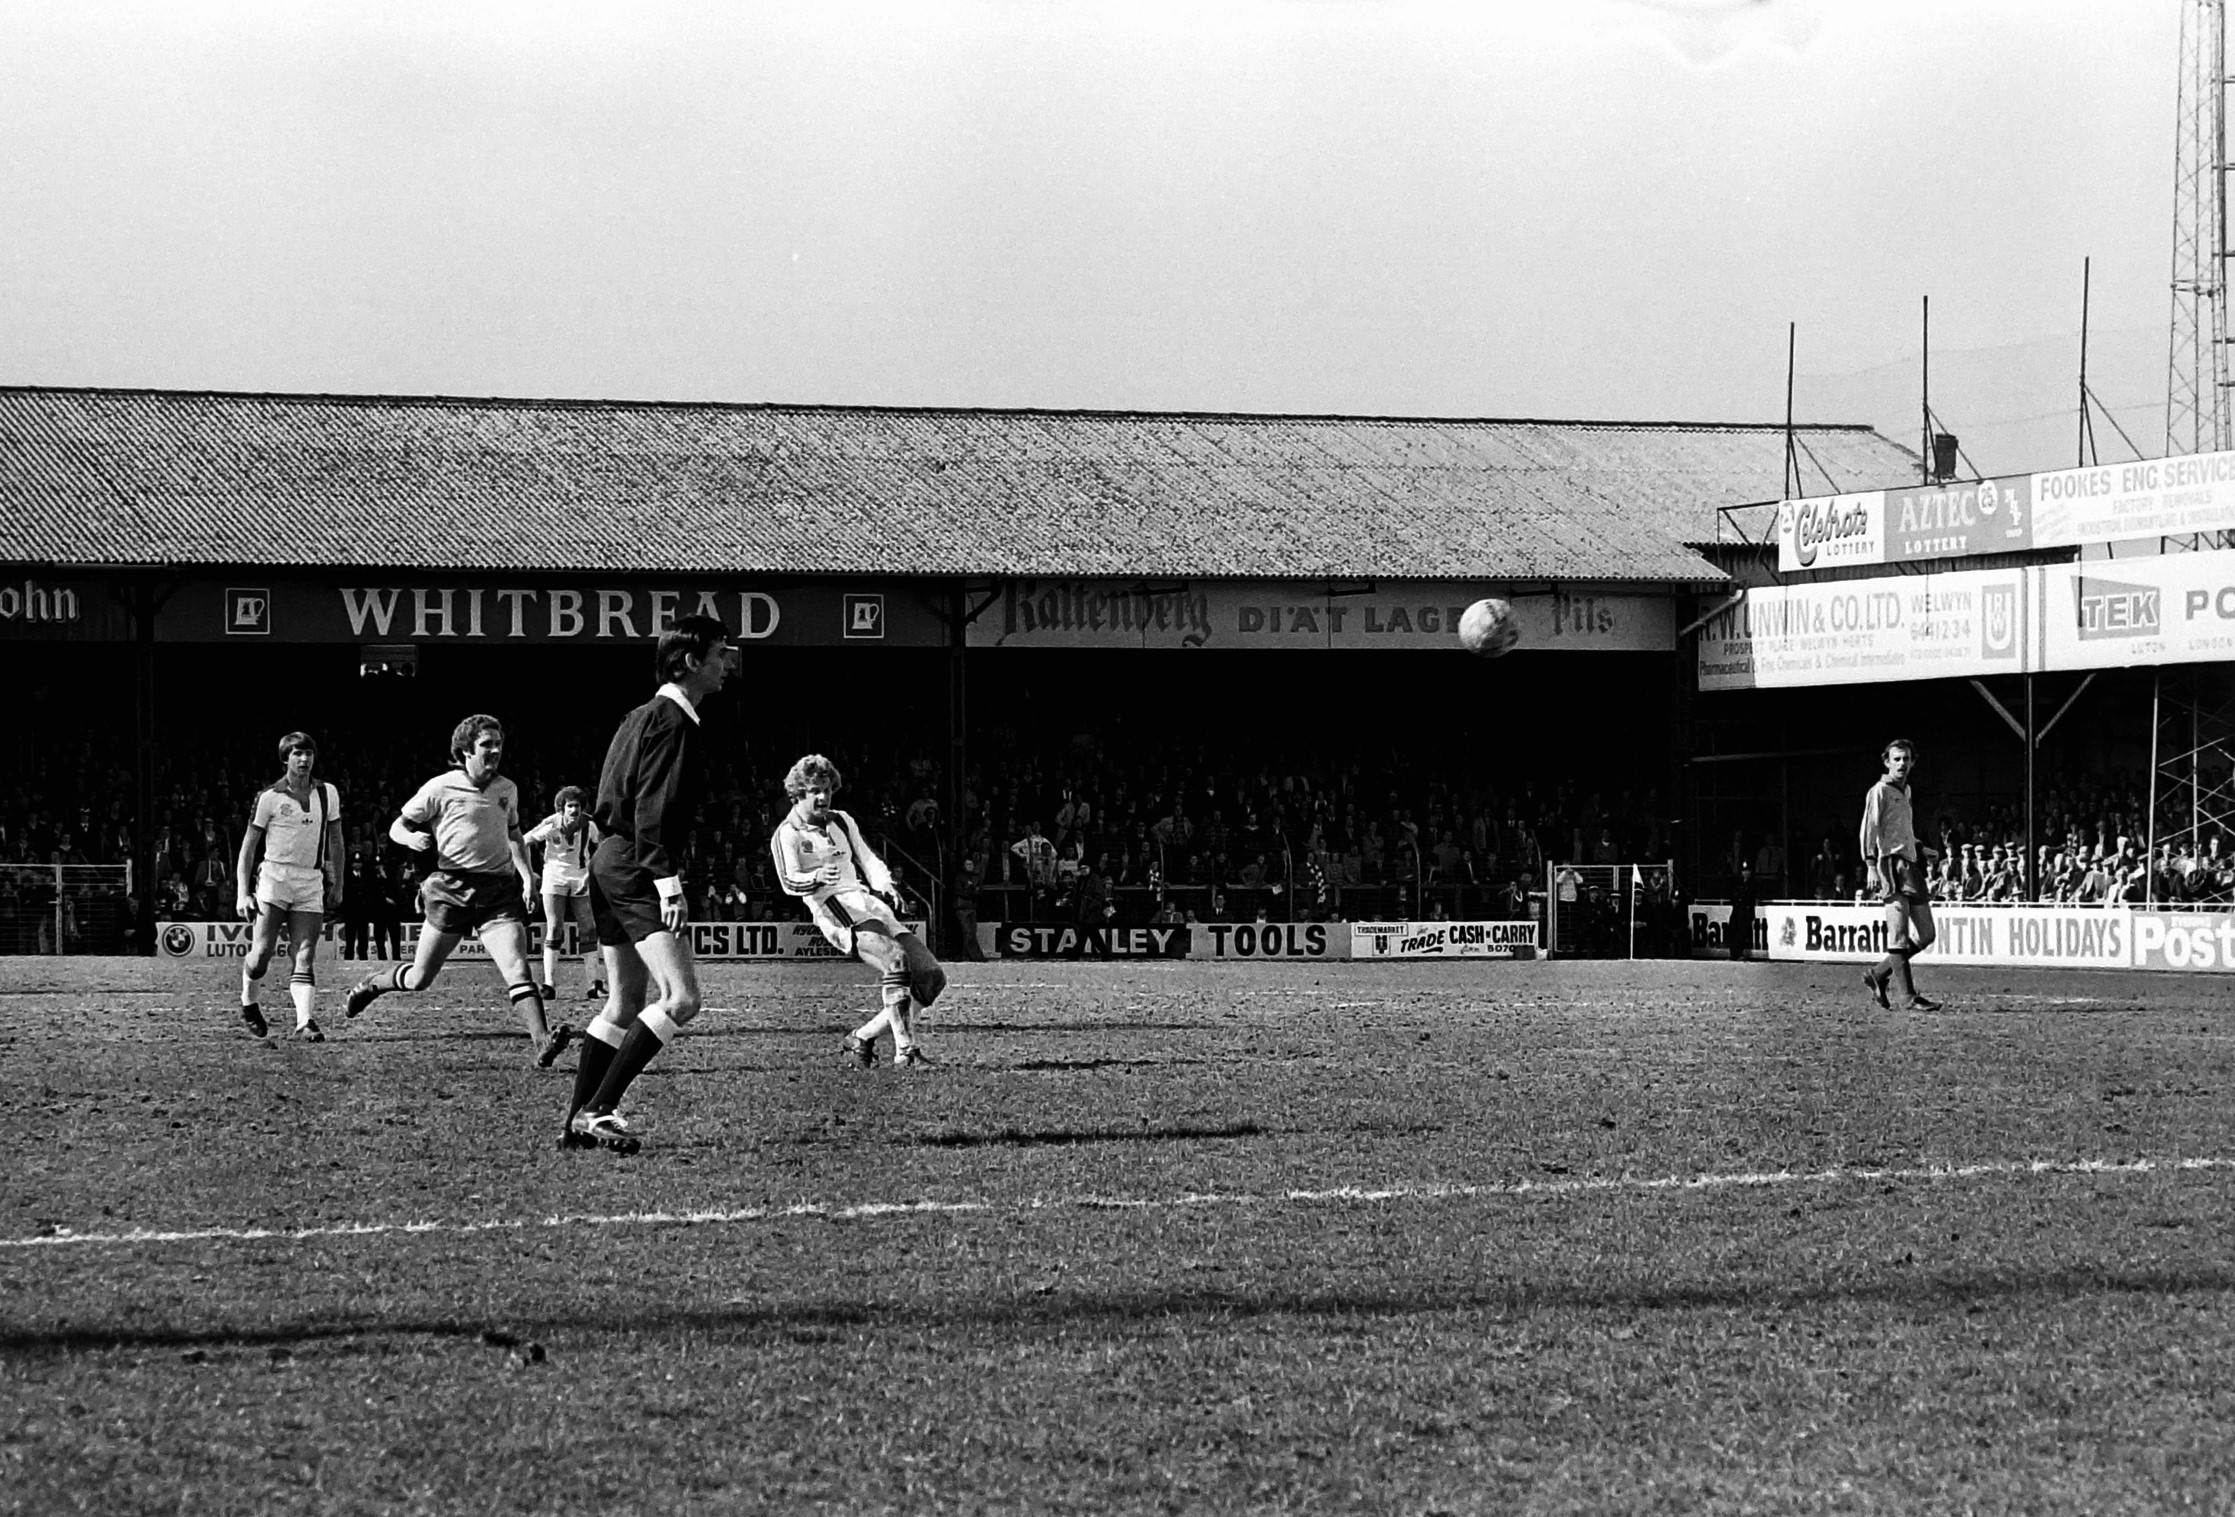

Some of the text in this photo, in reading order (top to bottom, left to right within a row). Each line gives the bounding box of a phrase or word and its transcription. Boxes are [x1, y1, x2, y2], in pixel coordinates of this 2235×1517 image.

[2041, 469, 2110, 501] FOOKES
[1898, 490, 1977, 532] AZTEC
[1795, 498, 1868, 567] Celebrate
[1826, 541, 1874, 556] LOTTERY
[1904, 535, 1967, 555] LOTTERY
[0, 579, 79, 622] ohn
[339, 588, 781, 639] WHITBREAD
[1364, 606, 1464, 633] LAGE
[1551, 593, 1613, 635] Pils
[1910, 591, 1972, 613] WELWYN
[2081, 591, 2158, 631] TEK
[1813, 602, 1826, 634] &
[206, 943, 252, 958] LUTO
[736, 925, 784, 955] LTD.
[1009, 927, 1175, 954] STANLEY
[1208, 924, 1327, 957] TOOLS
[1400, 929, 1446, 953] TRADE
[2009, 917, 2121, 958] HOLIDAYS
[2134, 915, 2235, 968] Post
